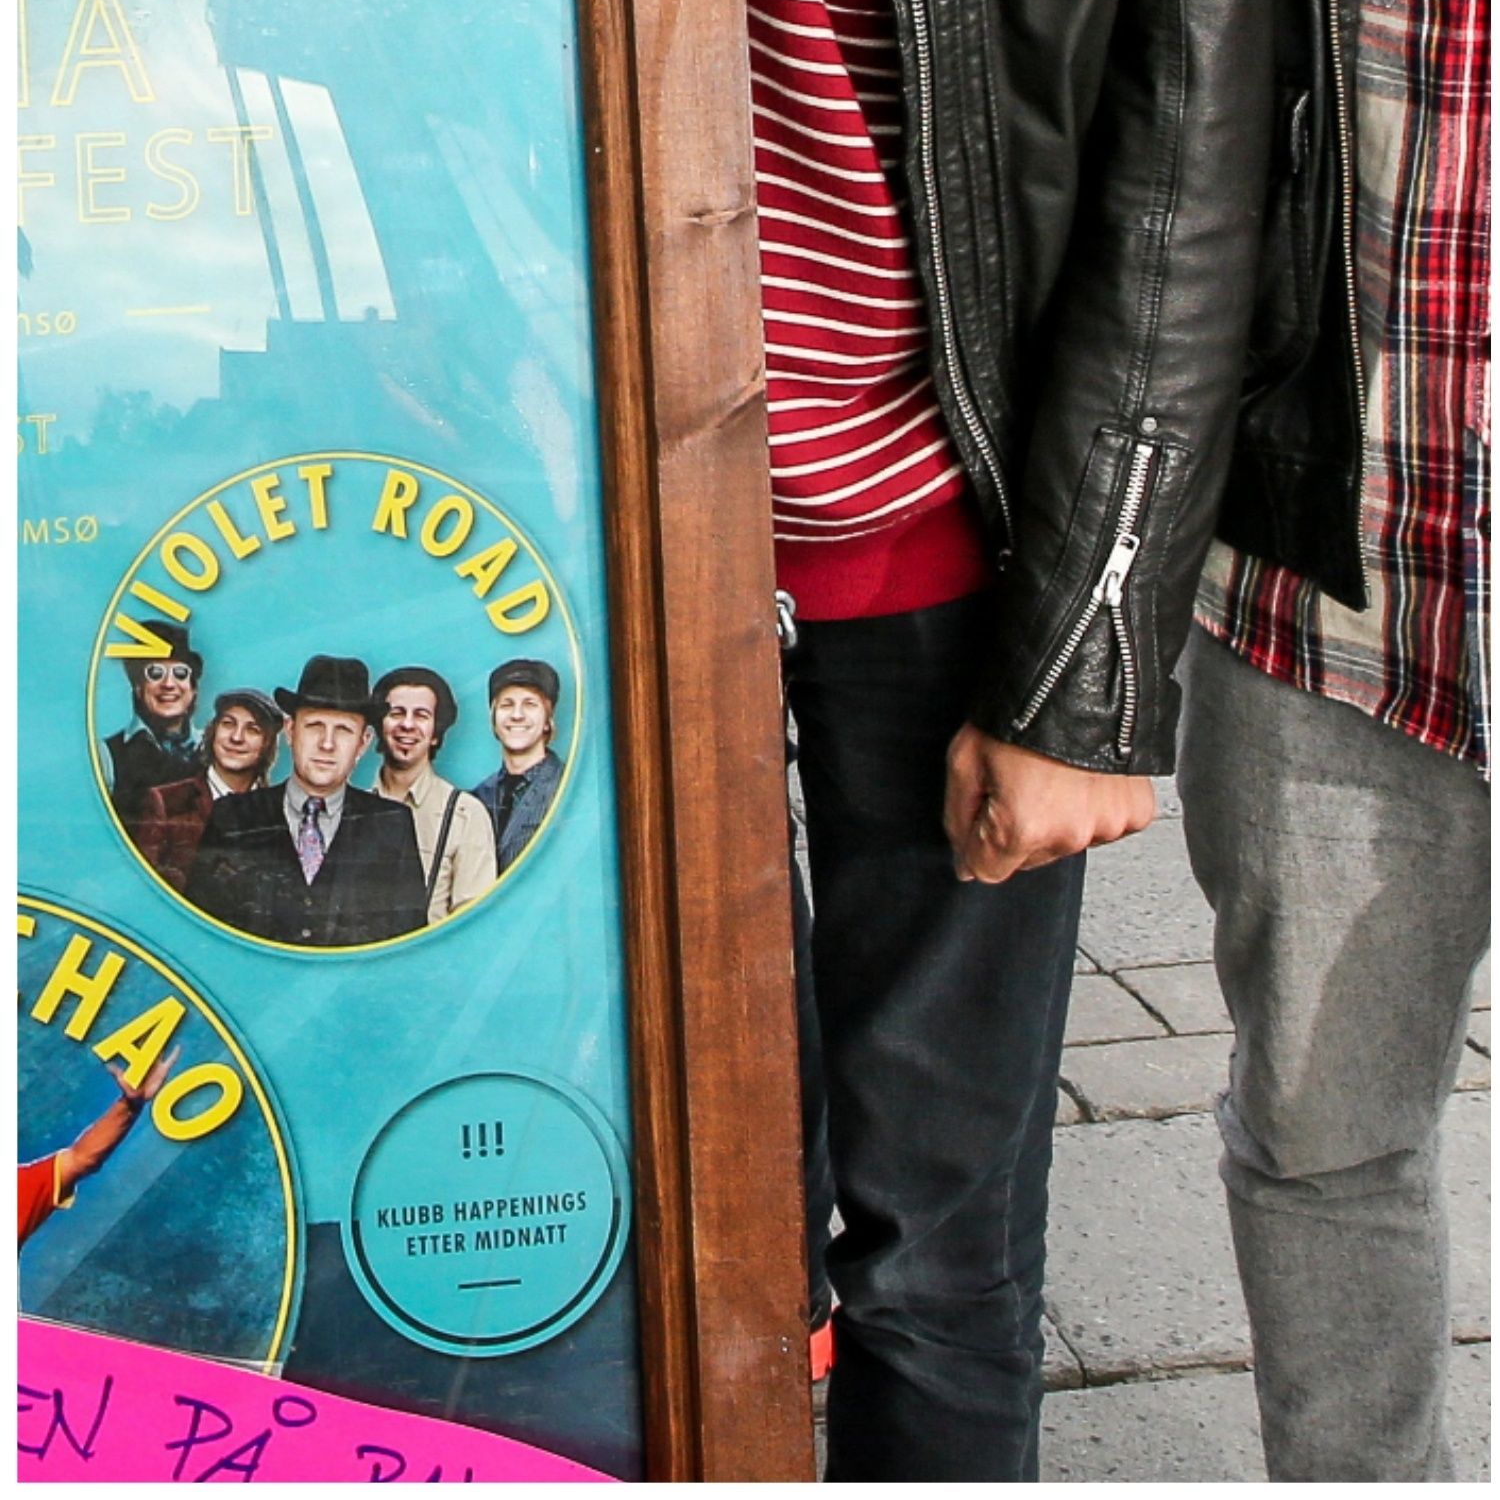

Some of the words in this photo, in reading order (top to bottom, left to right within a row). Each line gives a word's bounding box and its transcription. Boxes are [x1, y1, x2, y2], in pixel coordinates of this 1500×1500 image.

[105, 464, 333, 659] VIOLET
[372, 469, 550, 635] ROAD
[17, 913, 243, 1142] HAO
[377, 1204, 444, 1228] KLUBB
[454, 1191, 587, 1222] HAPPENINGS
[406, 1233, 466, 1257] ETTER
[475, 1224, 568, 1251] MIDNATT
